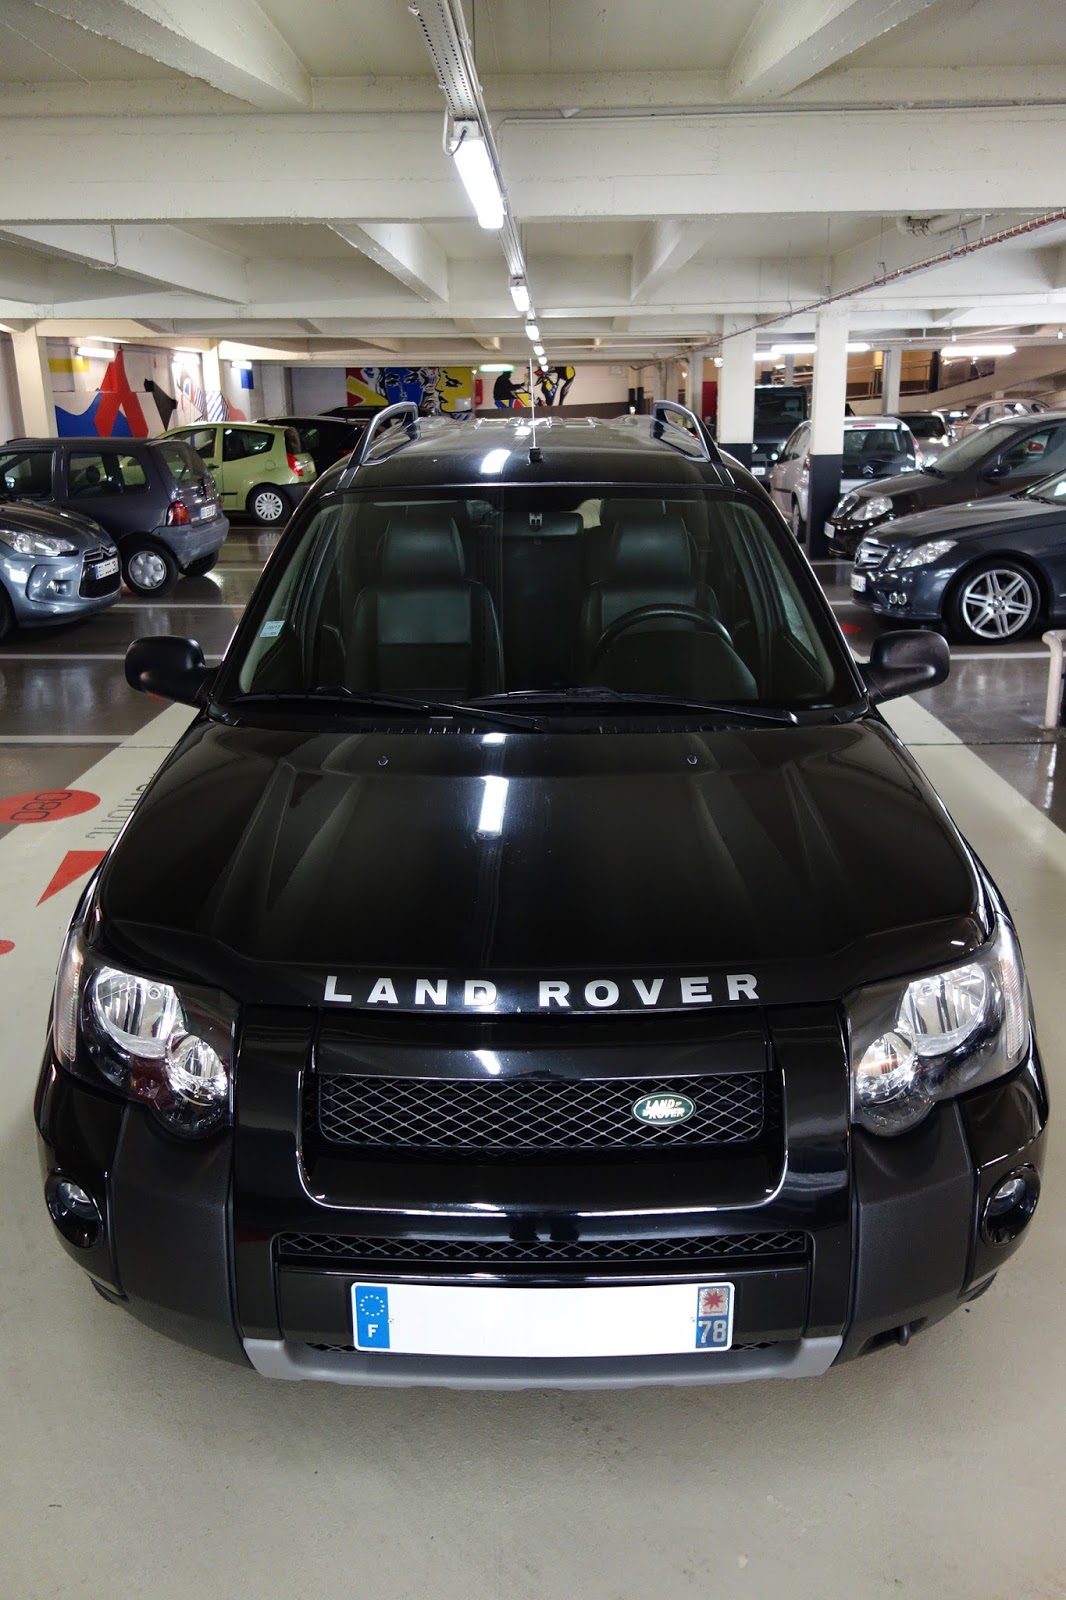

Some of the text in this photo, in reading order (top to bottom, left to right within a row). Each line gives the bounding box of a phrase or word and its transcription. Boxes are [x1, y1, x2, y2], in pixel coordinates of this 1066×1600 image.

[323, 973, 759, 1007] LAND ROVER
[645, 1099, 676, 1110] LAND
[647, 1107, 686, 1119] ROVER
[368, 1323, 379, 1338] F
[698, 1319, 727, 1343] 78
